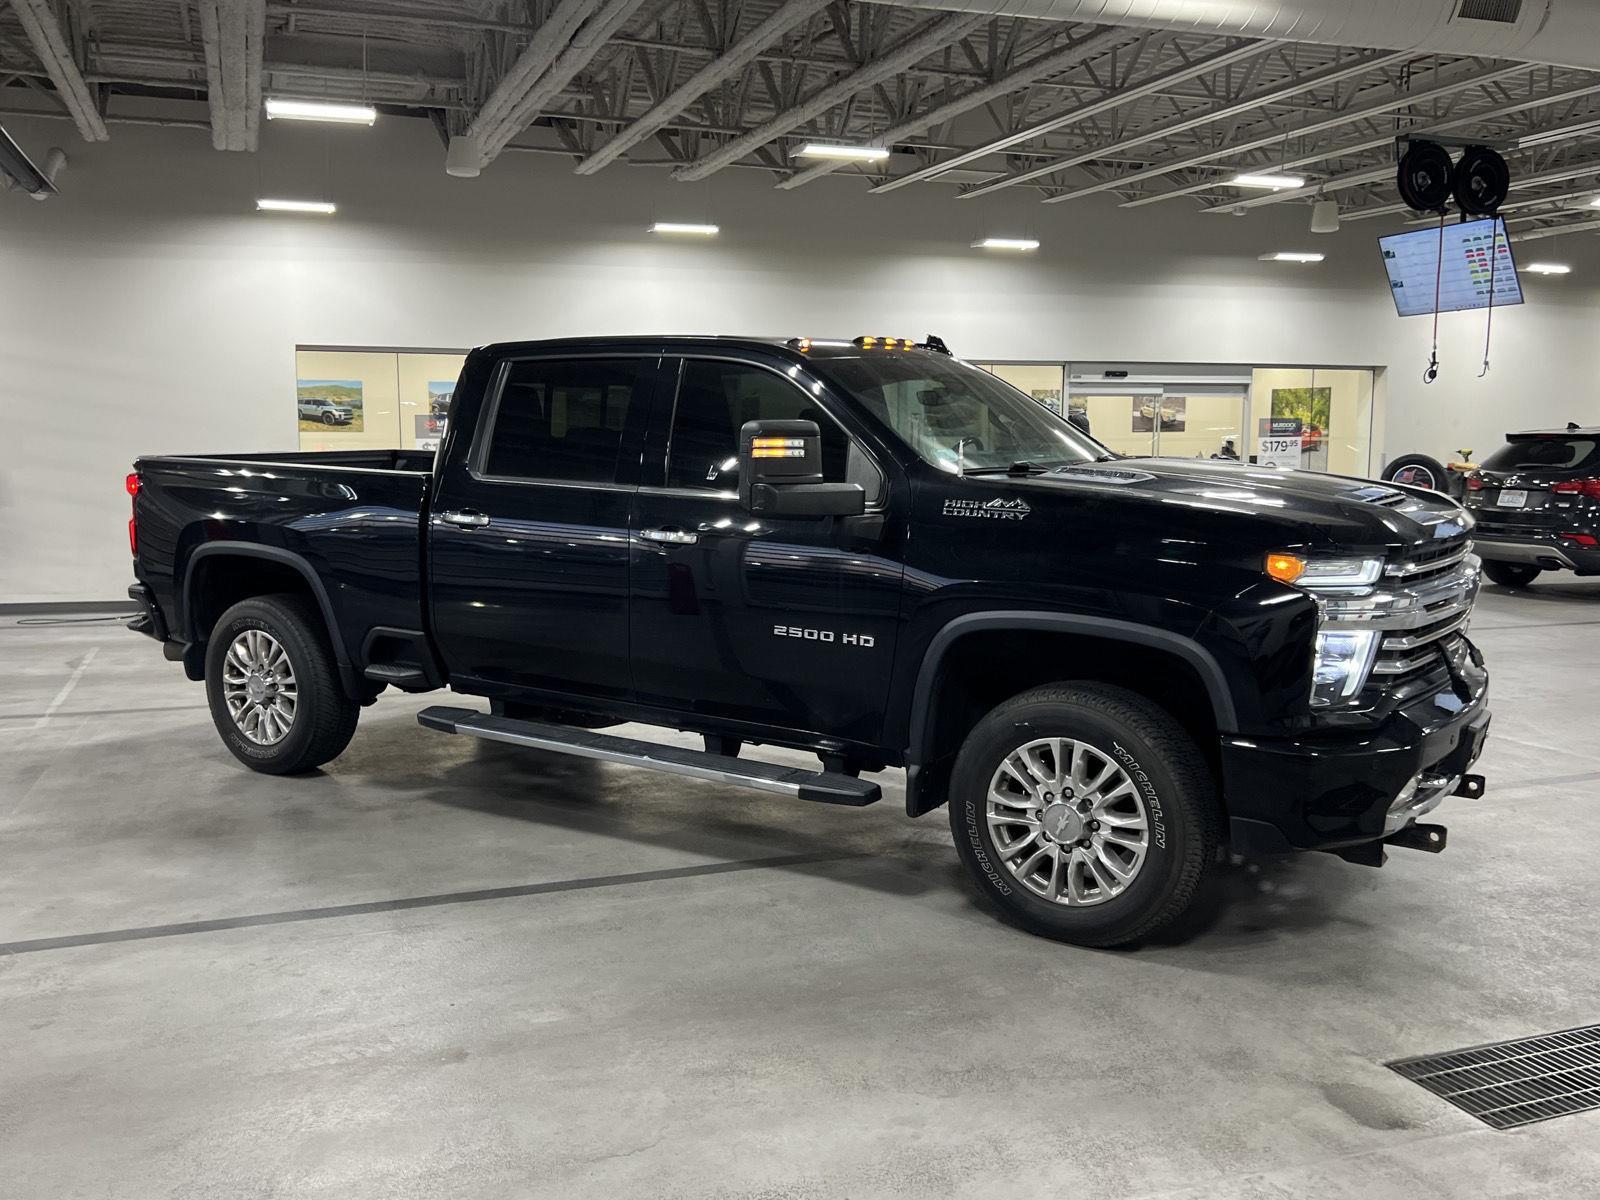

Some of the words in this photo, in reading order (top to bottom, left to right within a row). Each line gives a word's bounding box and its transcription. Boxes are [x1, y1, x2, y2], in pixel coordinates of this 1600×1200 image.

[1262, 440, 1299, 452] $179.95
[944, 499, 987, 509] HIGH
[942, 507, 1030, 520] COUNTRY
[773, 625, 835, 642] 2500
[842, 633, 875, 648] HD
[1112, 741, 1166, 849] MICHELIN
[965, 800, 1013, 897] MICHELIN
